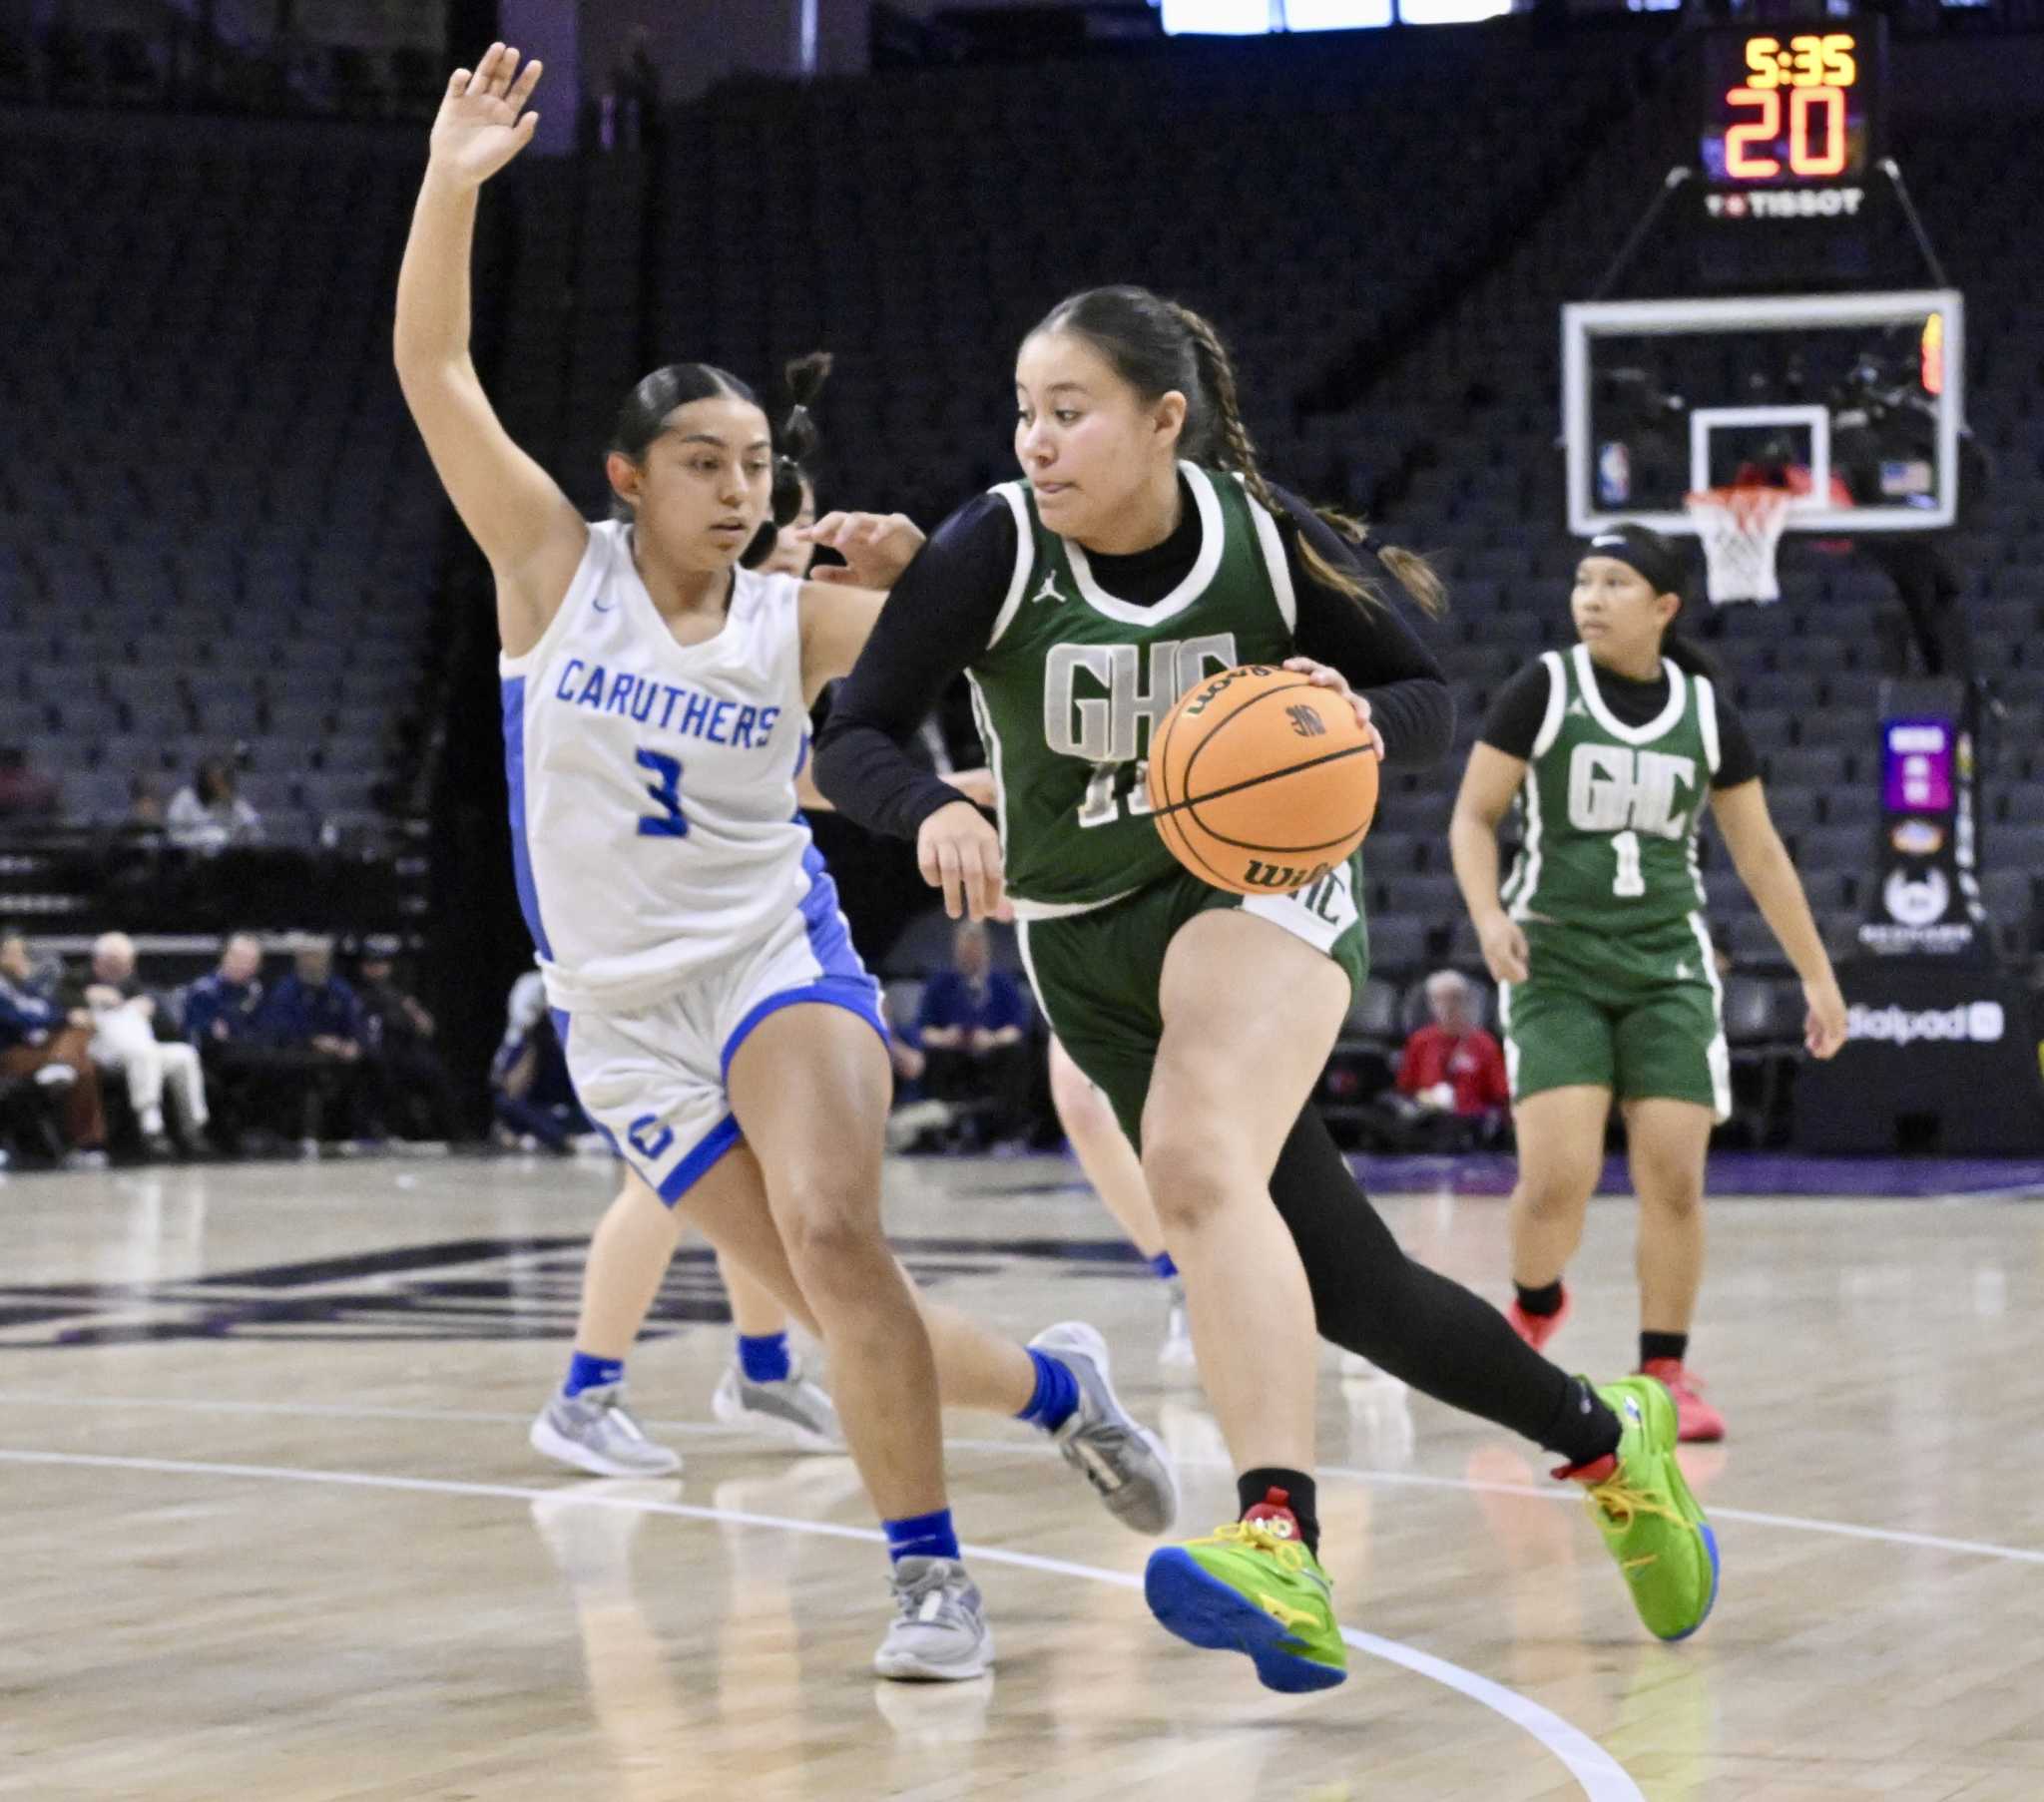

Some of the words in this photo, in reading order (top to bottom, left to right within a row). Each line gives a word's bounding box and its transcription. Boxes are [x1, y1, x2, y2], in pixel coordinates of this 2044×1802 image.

[1746, 34, 1855, 89] 5:35
[1725, 86, 1845, 178] 20
[1747, 188, 1864, 217] TISSOT
[556, 659, 780, 748] CARUTHERS
[636, 749, 688, 837] 3
[1569, 744, 1695, 839] GHC
[1610, 829, 1646, 897] 1
